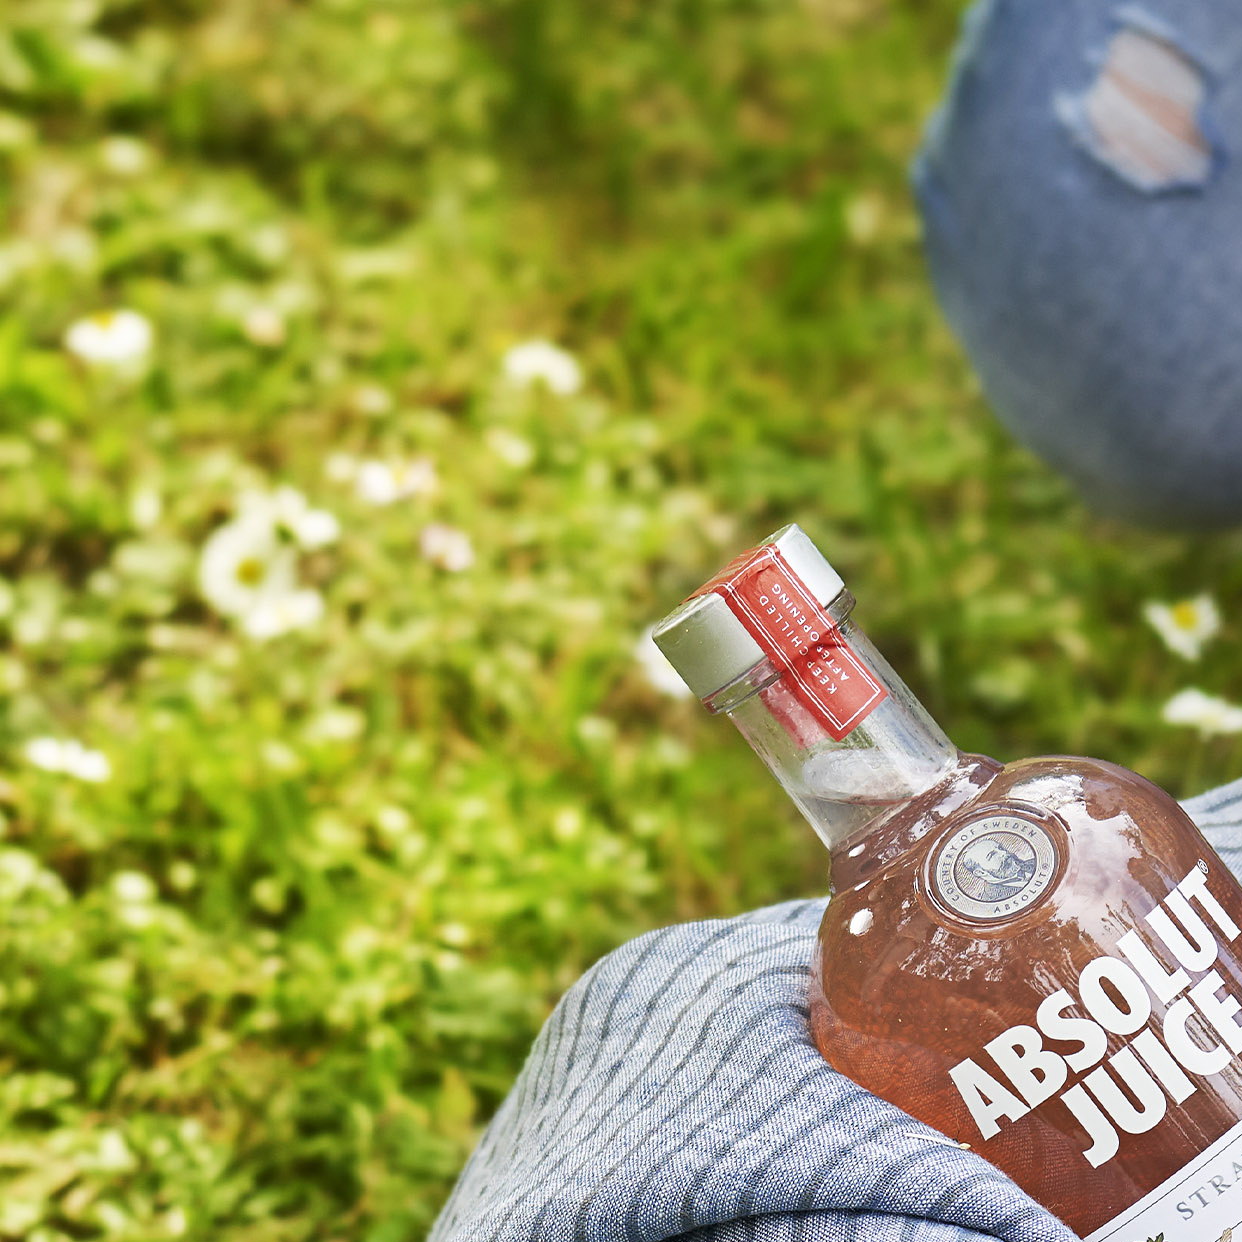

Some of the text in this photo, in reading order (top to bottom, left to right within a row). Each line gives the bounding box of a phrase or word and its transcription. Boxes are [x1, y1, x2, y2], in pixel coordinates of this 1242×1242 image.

[760, 595, 838, 694] KEEP CHILLED
[772, 584, 850, 681] AFTER OPENING
[942, 821, 1038, 902] COUNTRY OF SWEDEN
